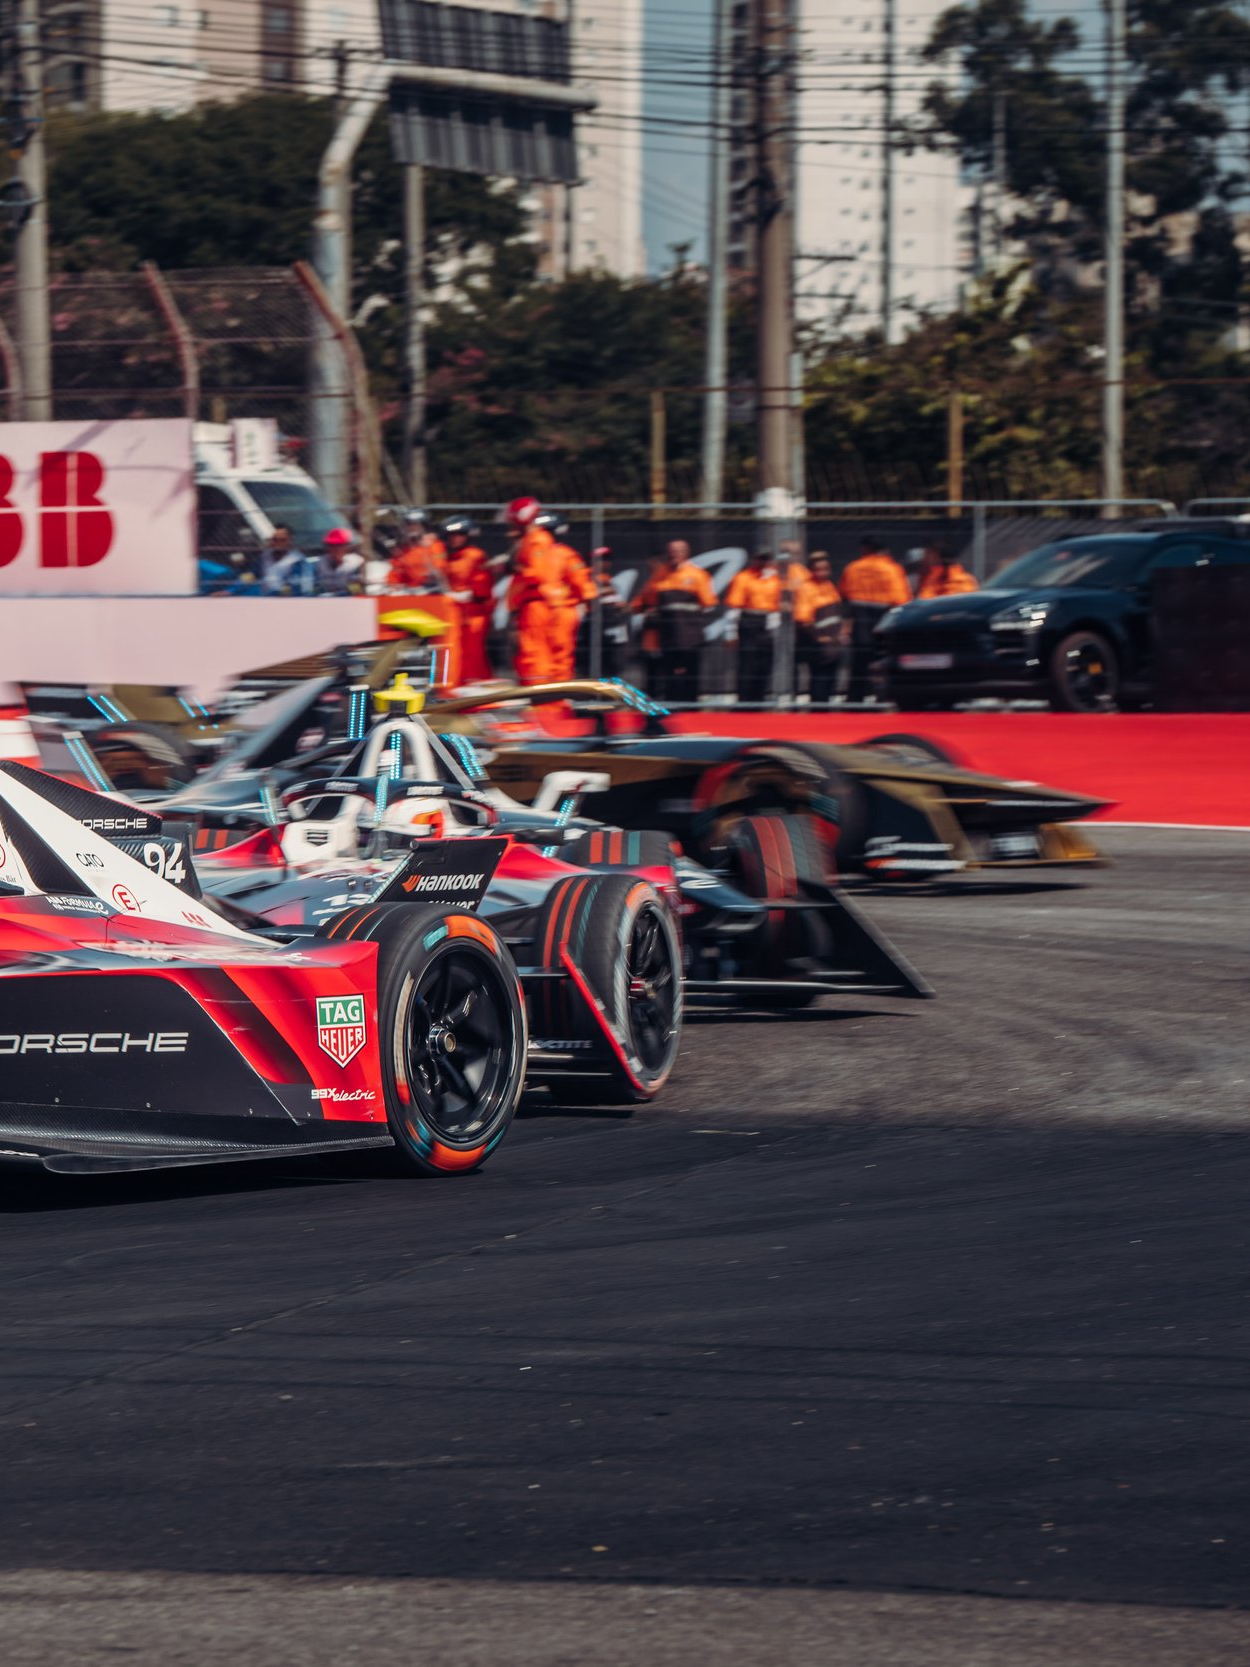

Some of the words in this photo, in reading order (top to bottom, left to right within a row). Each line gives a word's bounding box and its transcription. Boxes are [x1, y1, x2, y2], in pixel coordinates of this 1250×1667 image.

[81, 817, 148, 830] ORSCHE
[143, 842, 187, 884] 94
[320, 1001, 361, 1023] TAG
[321, 1027, 363, 1061] HEUER
